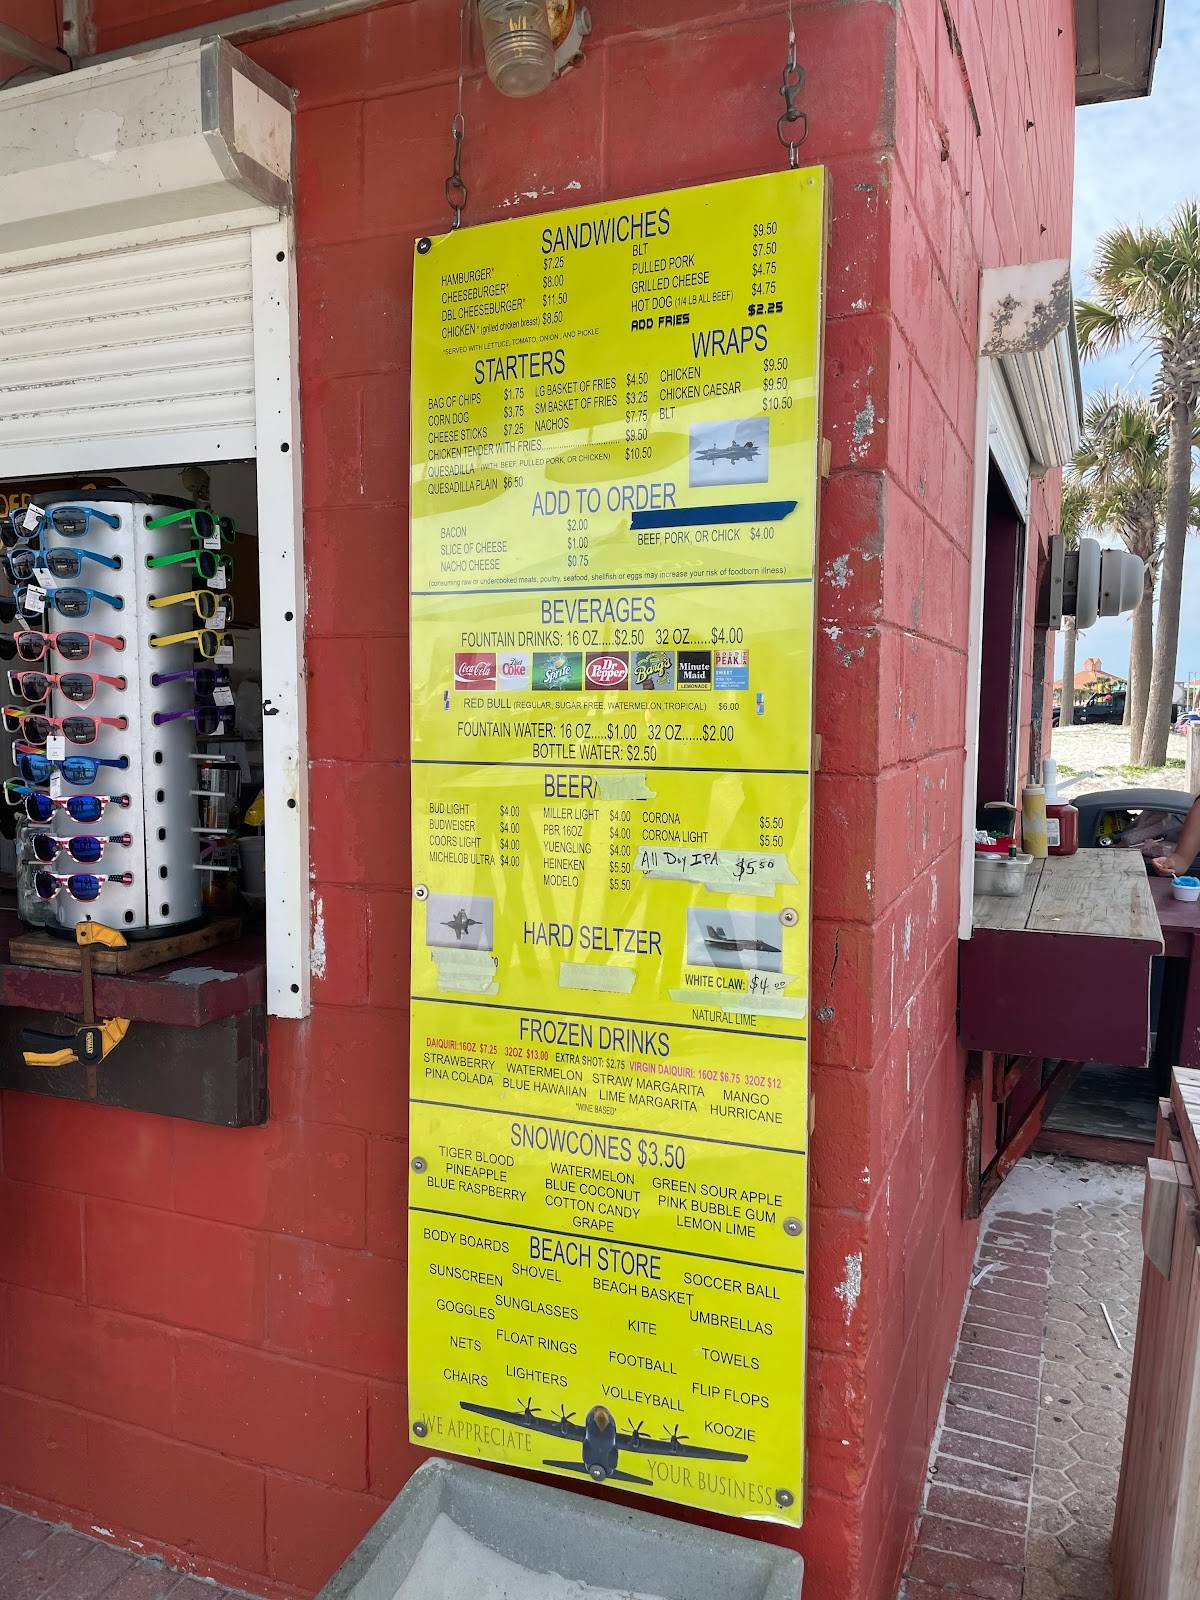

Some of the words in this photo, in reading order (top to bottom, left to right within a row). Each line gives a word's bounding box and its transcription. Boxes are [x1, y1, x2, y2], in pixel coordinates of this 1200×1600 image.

[541, 207, 670, 254] SANDWICHES
[633, 243, 648, 256] BLT
[753, 222, 777, 237] $9.50
[544, 257, 564, 270] $7.25
[633, 258, 666, 275] PULLED
[669, 254, 695, 270] PORK
[753, 242, 776, 257] $7.50
[543, 275, 563, 289] $8.00
[632, 278, 669, 293] GRILLED
[672, 272, 709, 288] CHEESE
[752, 262, 776, 277] $4.75
[441, 308, 456, 321] DBL
[543, 293, 567, 307] $11.50
[632, 299, 649, 312] HOT
[652, 296, 672, 310] DOG
[752, 282, 776, 296] $4.75
[631, 318, 653, 332] ADD
[658, 314, 689, 329] FRIES
[748, 302, 783, 316] $2.25
[692, 324, 767, 358] WRAPS
[474, 349, 566, 385] STARTERS
[660, 367, 700, 382] CHICKEN
[763, 358, 787, 371] $9.50
[660, 385, 700, 401] CHICKEN
[703, 381, 741, 397] CAESAR
[763, 378, 787, 391] $9.50
[428, 415, 449, 426] CORN
[453, 412, 469, 423] DOG
[504, 406, 524, 419] $3.75
[659, 407, 675, 420] BLT
[762, 397, 792, 411] $10.50
[535, 418, 568, 432] NACHOS
[625, 409, 647, 423] $7.75
[428, 429, 459, 444] CHEESE
[461, 427, 487, 441] STICKS
[504, 424, 523, 436] $7.25
[532, 489, 570, 516] ADD
[576, 487, 600, 513] TO
[607, 483, 676, 512] ORDER
[695, 530, 709, 543] OR
[712, 528, 740, 541] CHICK
[750, 527, 774, 541] $4.00
[541, 596, 656, 624] BEVERAGES
[502, 663, 526, 676] Coke
[544, 666, 571, 683] Sprite
[591, 665, 625, 681] Pepper
[602, 659, 617, 670] Dr
[679, 663, 709, 671] Minute
[683, 670, 706, 679] Maid
[532, 743, 575, 759] BOTTLE
[580, 745, 623, 760] WATER:
[627, 745, 657, 761] $2.50
[429, 803, 444, 814] BUD
[447, 804, 469, 814] LIGHT
[500, 806, 519, 816] $4.00
[642, 811, 680, 824] CORONA
[760, 817, 783, 829] $5.50
[544, 825, 559, 835] PBR
[563, 826, 582, 836] 16OZ
[609, 828, 631, 839] $4.00
[642, 830, 680, 842] CORONA
[683, 831, 708, 843] LIGHT
[760, 835, 783, 847] $5.50
[544, 842, 591, 854] YUENGLING
[609, 845, 630, 856] $4.00
[641, 851, 658, 867] All
[690, 852, 719, 866] IPA
[544, 858, 585, 871] HEINEKEN
[610, 862, 630, 874] $5.50
[524, 921, 573, 947] HARD
[579, 925, 662, 955] SELTZER
[685, 974, 713, 987] WHITE
[717, 976, 746, 990] CLAW:
[520, 1017, 592, 1048] FROZEN
[599, 1026, 670, 1057] DRINKS
[424, 1053, 495, 1070] STRAWBERRY
[506, 1063, 582, 1081] WATERMELON
[592, 1073, 633, 1088] STRAW
[637, 1078, 705, 1096] MARGARITA
[723, 1090, 769, 1105] MANGO
[425, 1068, 449, 1080] PINA
[452, 1072, 494, 1085] COLADA
[503, 1078, 529, 1090] BLUE
[533, 1081, 587, 1097] HAWAIIAN
[599, 1089, 625, 1103] LIME
[629, 1094, 697, 1112] MARGARITA
[710, 1104, 783, 1123] HURRICANE
[439, 1146, 472, 1160] TIGER
[476, 1152, 514, 1167] BLOOD
[511, 1122, 632, 1162] SNOWCONES
[638, 1139, 685, 1169] $3.50
[446, 1163, 507, 1182] PINEAPPLE
[551, 1162, 635, 1185] WATERMELON
[428, 1176, 455, 1190] BLUE
[459, 1181, 526, 1201] RASPBERRY
[545, 1179, 575, 1193] BLUE
[579, 1184, 640, 1202] COCONUT
[652, 1177, 696, 1194] GREEN
[701, 1184, 737, 1200] SOUR
[741, 1190, 782, 1206] APPLE
[545, 1195, 594, 1213] COTTON
[598, 1202, 640, 1220] CANDY
[658, 1195, 686, 1210] PINK
[692, 1200, 740, 1218] BUBBLE
[746, 1209, 776, 1223] GUM
[572, 1216, 614, 1232] GRAPE
[676, 1215, 721, 1232] LEMON
[726, 1224, 756, 1238] LIME
[424, 1228, 456, 1244] BODY
[460, 1235, 509, 1253] BOARDS
[530, 1235, 591, 1268] BEACH
[598, 1247, 661, 1280] STORE
[429, 1263, 503, 1287] SUNSCREEN
[512, 1263, 561, 1282] SHOVEL
[593, 1278, 636, 1295] BEACH
[642, 1286, 694, 1306] BASKET
[684, 1272, 742, 1293] SOCCER
[746, 1283, 780, 1300] BALL
[437, 1299, 495, 1320] GOGGLES
[495, 1295, 578, 1320] SUNGLASSES
[628, 1320, 657, 1335] KITE
[690, 1310, 773, 1335] UMBRELLAS
[450, 1336, 481, 1351] NETS
[496, 1329, 534, 1345] FLOAT
[538, 1337, 577, 1355] RINGS
[609, 1351, 677, 1375] FOOTBALL
[702, 1348, 760, 1370] TOWELS
[444, 1368, 488, 1387] CHAIRS
[506, 1365, 568, 1387] LIGHTERS
[602, 1384, 684, 1411] VOLLEYBALL
[692, 1382, 720, 1398] FLIP
[724, 1388, 769, 1408] FLOPS
[422, 1413, 442, 1434] WE
[448, 1420, 532, 1452] APPRECIATE
[704, 1420, 756, 1442] KOOZIE
[647, 1459, 693, 1488] YOUR
[698, 1471, 772, 1506] BUSINESS
